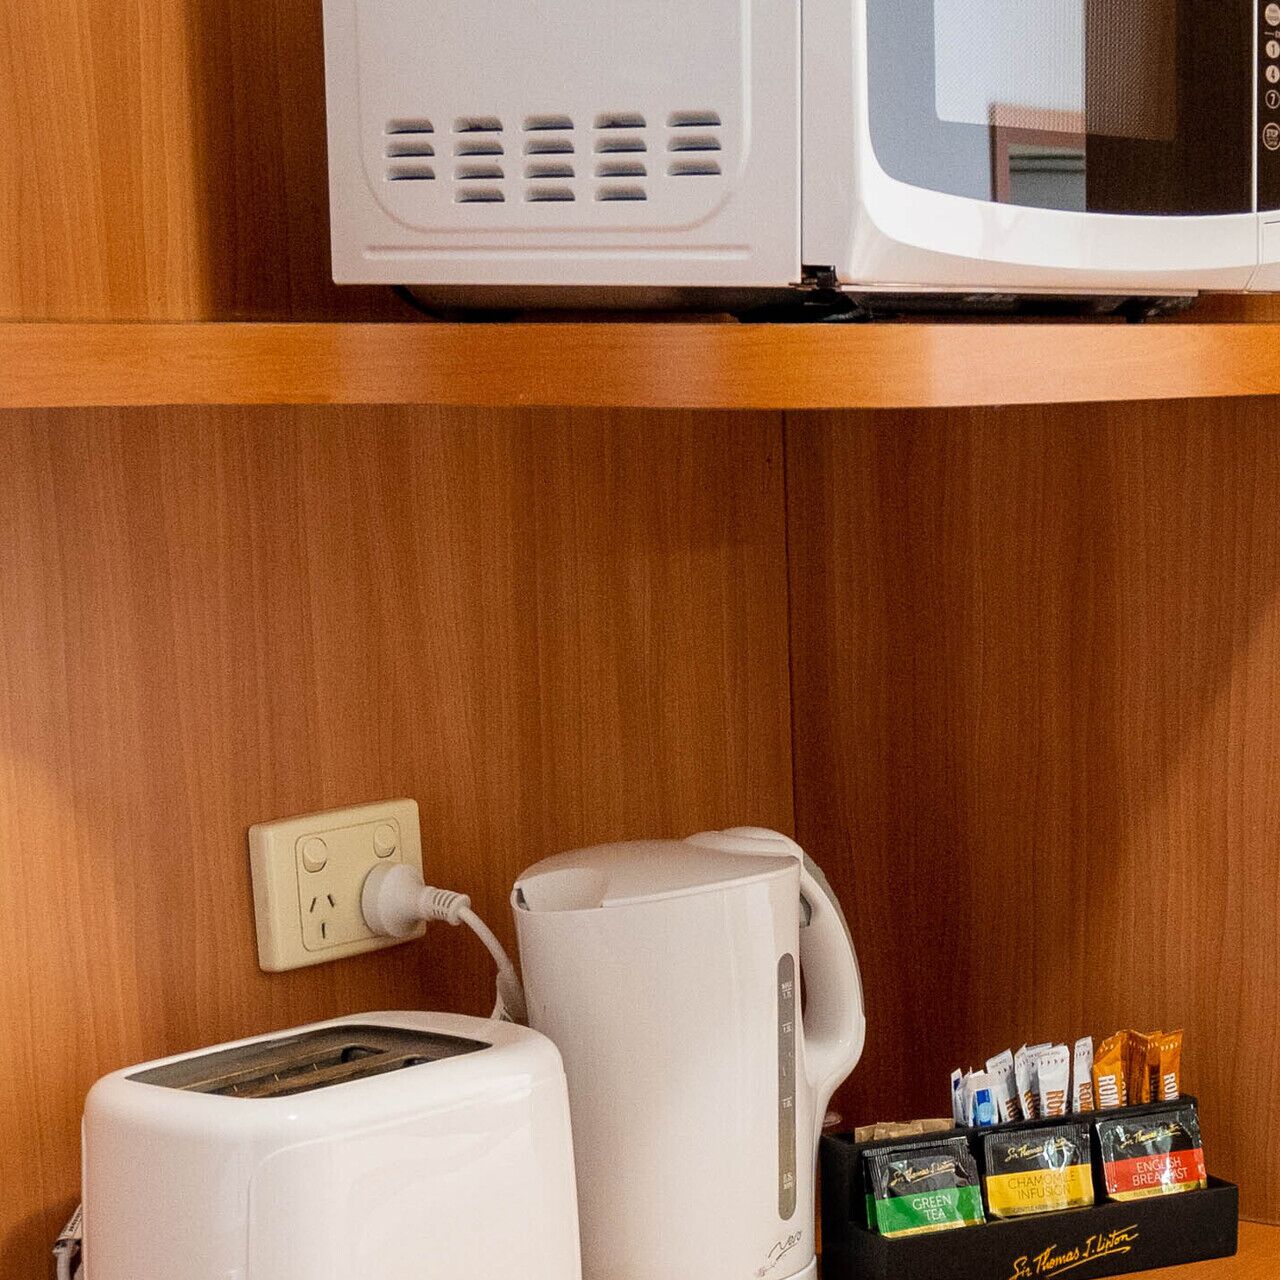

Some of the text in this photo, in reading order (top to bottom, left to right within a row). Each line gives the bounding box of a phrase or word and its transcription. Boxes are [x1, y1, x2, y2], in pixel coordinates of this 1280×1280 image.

[1098, 1074, 1120, 1111] ROM
[1136, 1156, 1183, 1174] ENGLSH
[1132, 1166, 1188, 1187] BREAAST
[1017, 1184, 1071, 1200] INFUSION
[912, 1194, 953, 1211] GREEN
[923, 1208, 947, 1221] TEA
[1033, 1243, 1080, 1275] Thomas
[1096, 1224, 1139, 1254] Lipton
